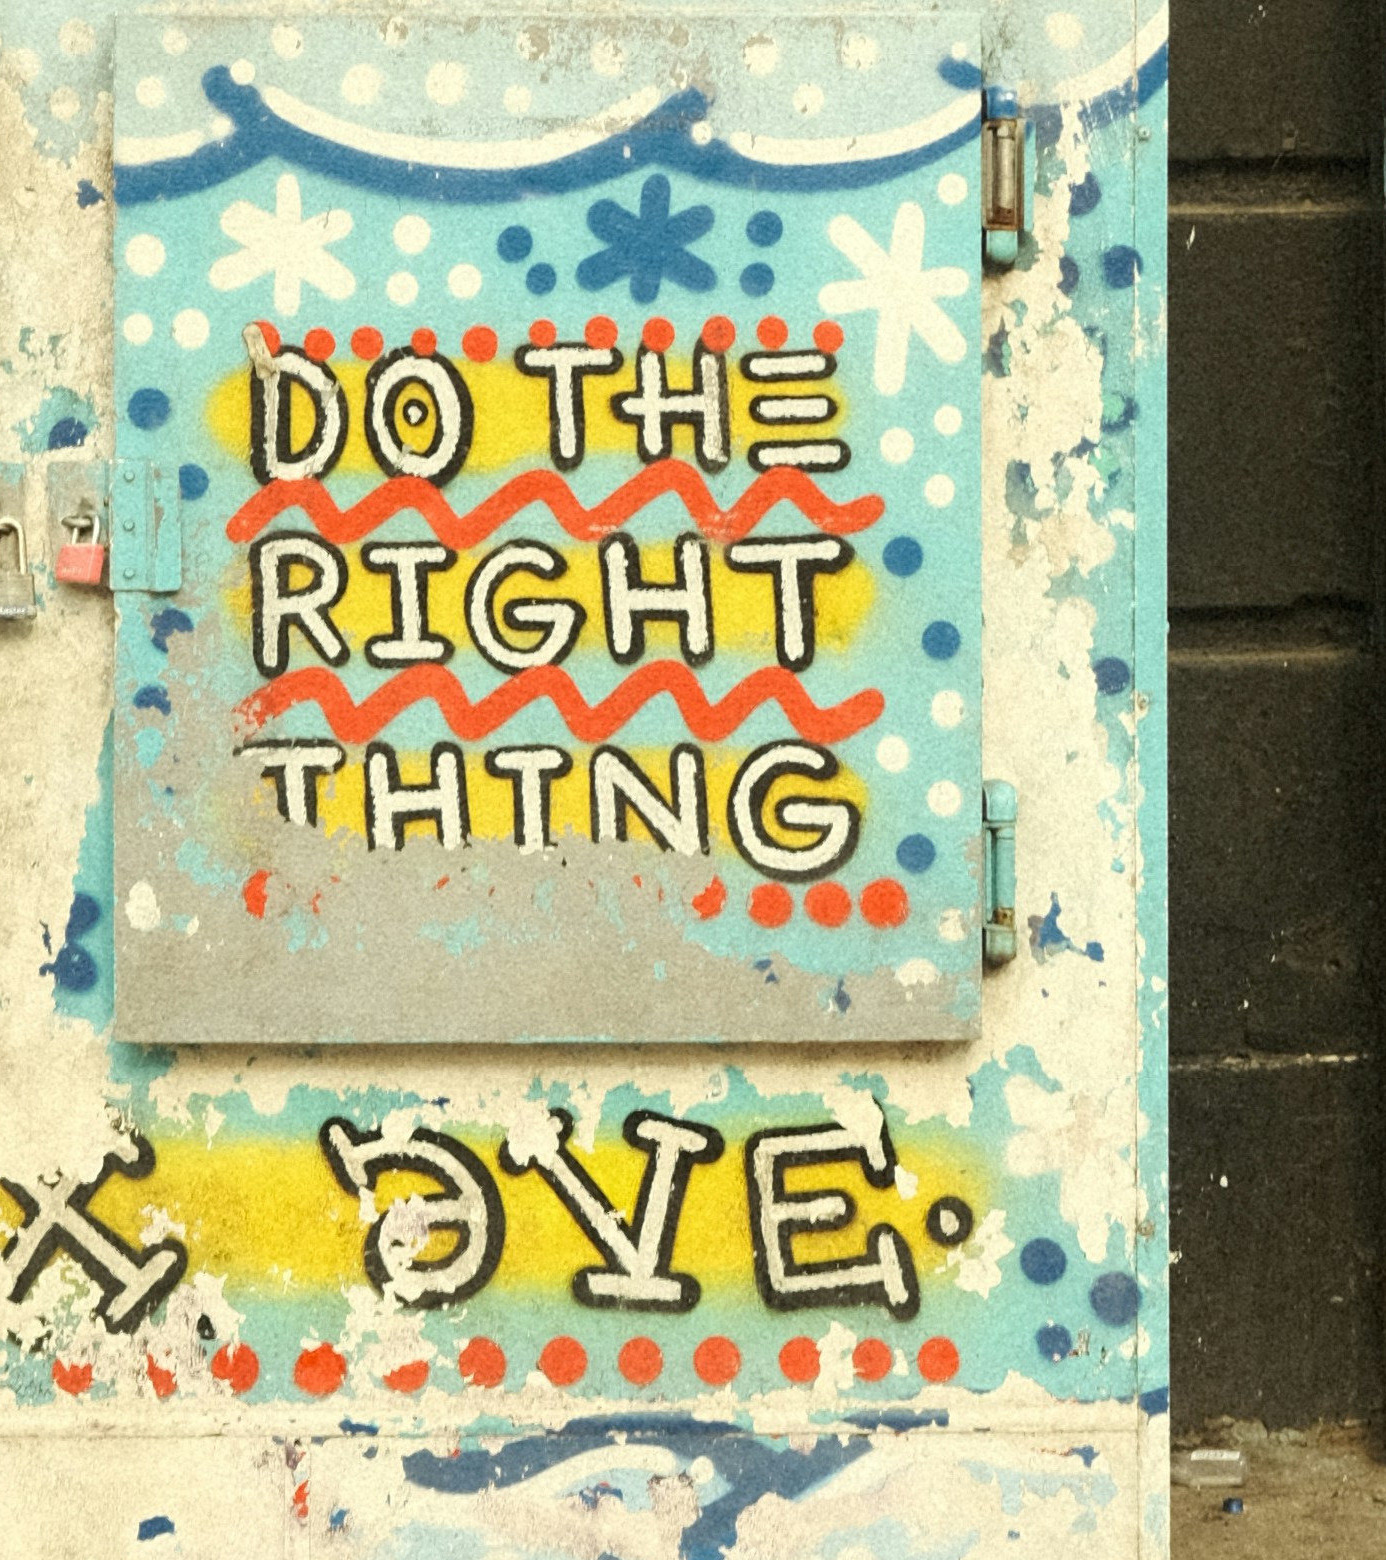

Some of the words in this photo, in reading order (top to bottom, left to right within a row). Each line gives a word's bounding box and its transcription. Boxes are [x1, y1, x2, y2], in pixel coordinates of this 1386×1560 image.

[248, 342, 475, 485] DO
[515, 336, 853, 476] THE
[247, 530, 856, 677] RIGHT
[233, 740, 861, 881] THING
